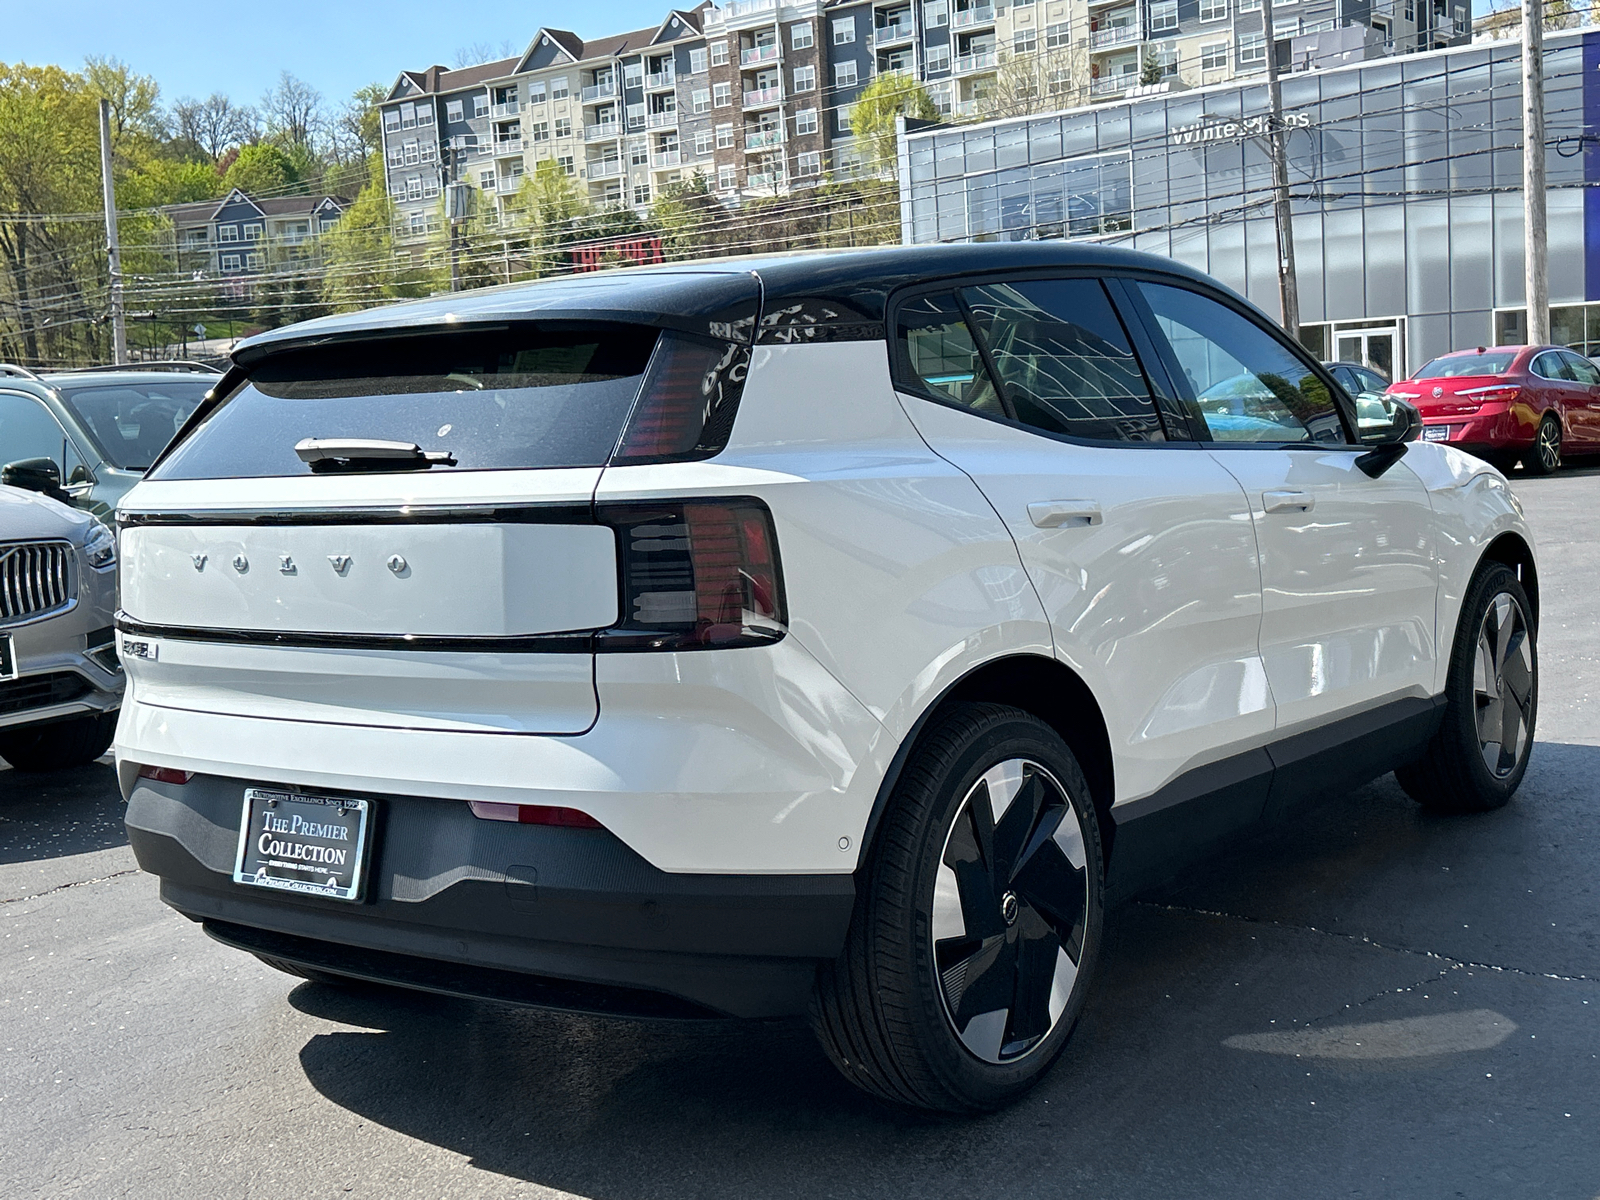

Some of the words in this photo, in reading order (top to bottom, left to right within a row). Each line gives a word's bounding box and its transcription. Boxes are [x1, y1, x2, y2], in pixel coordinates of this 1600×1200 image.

[190, 553, 408, 574] VOLVO
[262, 811, 289, 833] THE
[290, 815, 349, 840] PREMIER
[258, 833, 347, 865] COLLECTION
